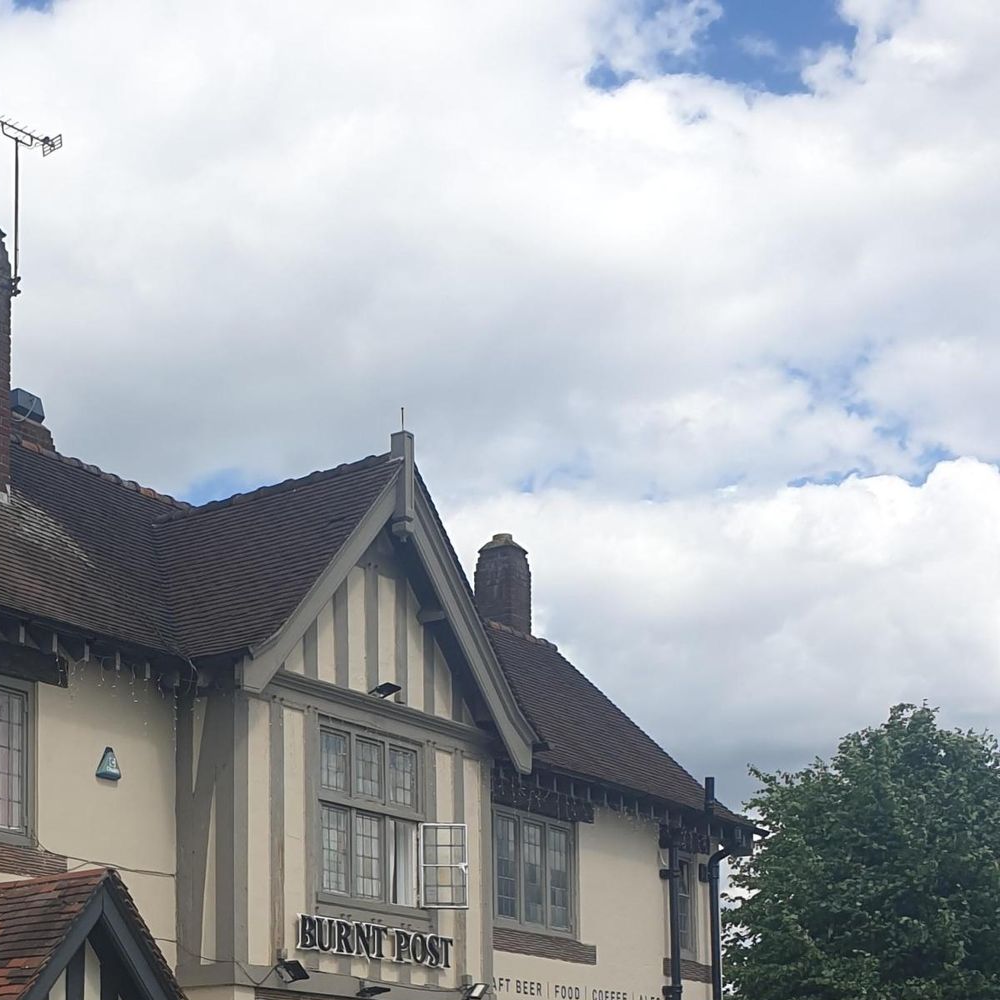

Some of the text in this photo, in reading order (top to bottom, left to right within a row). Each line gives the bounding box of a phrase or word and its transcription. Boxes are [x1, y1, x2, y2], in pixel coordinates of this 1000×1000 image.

[296, 913, 453, 968] BURNT POST
[515, 979, 542, 996] BEER
[555, 984, 580, 1000] FOOD
